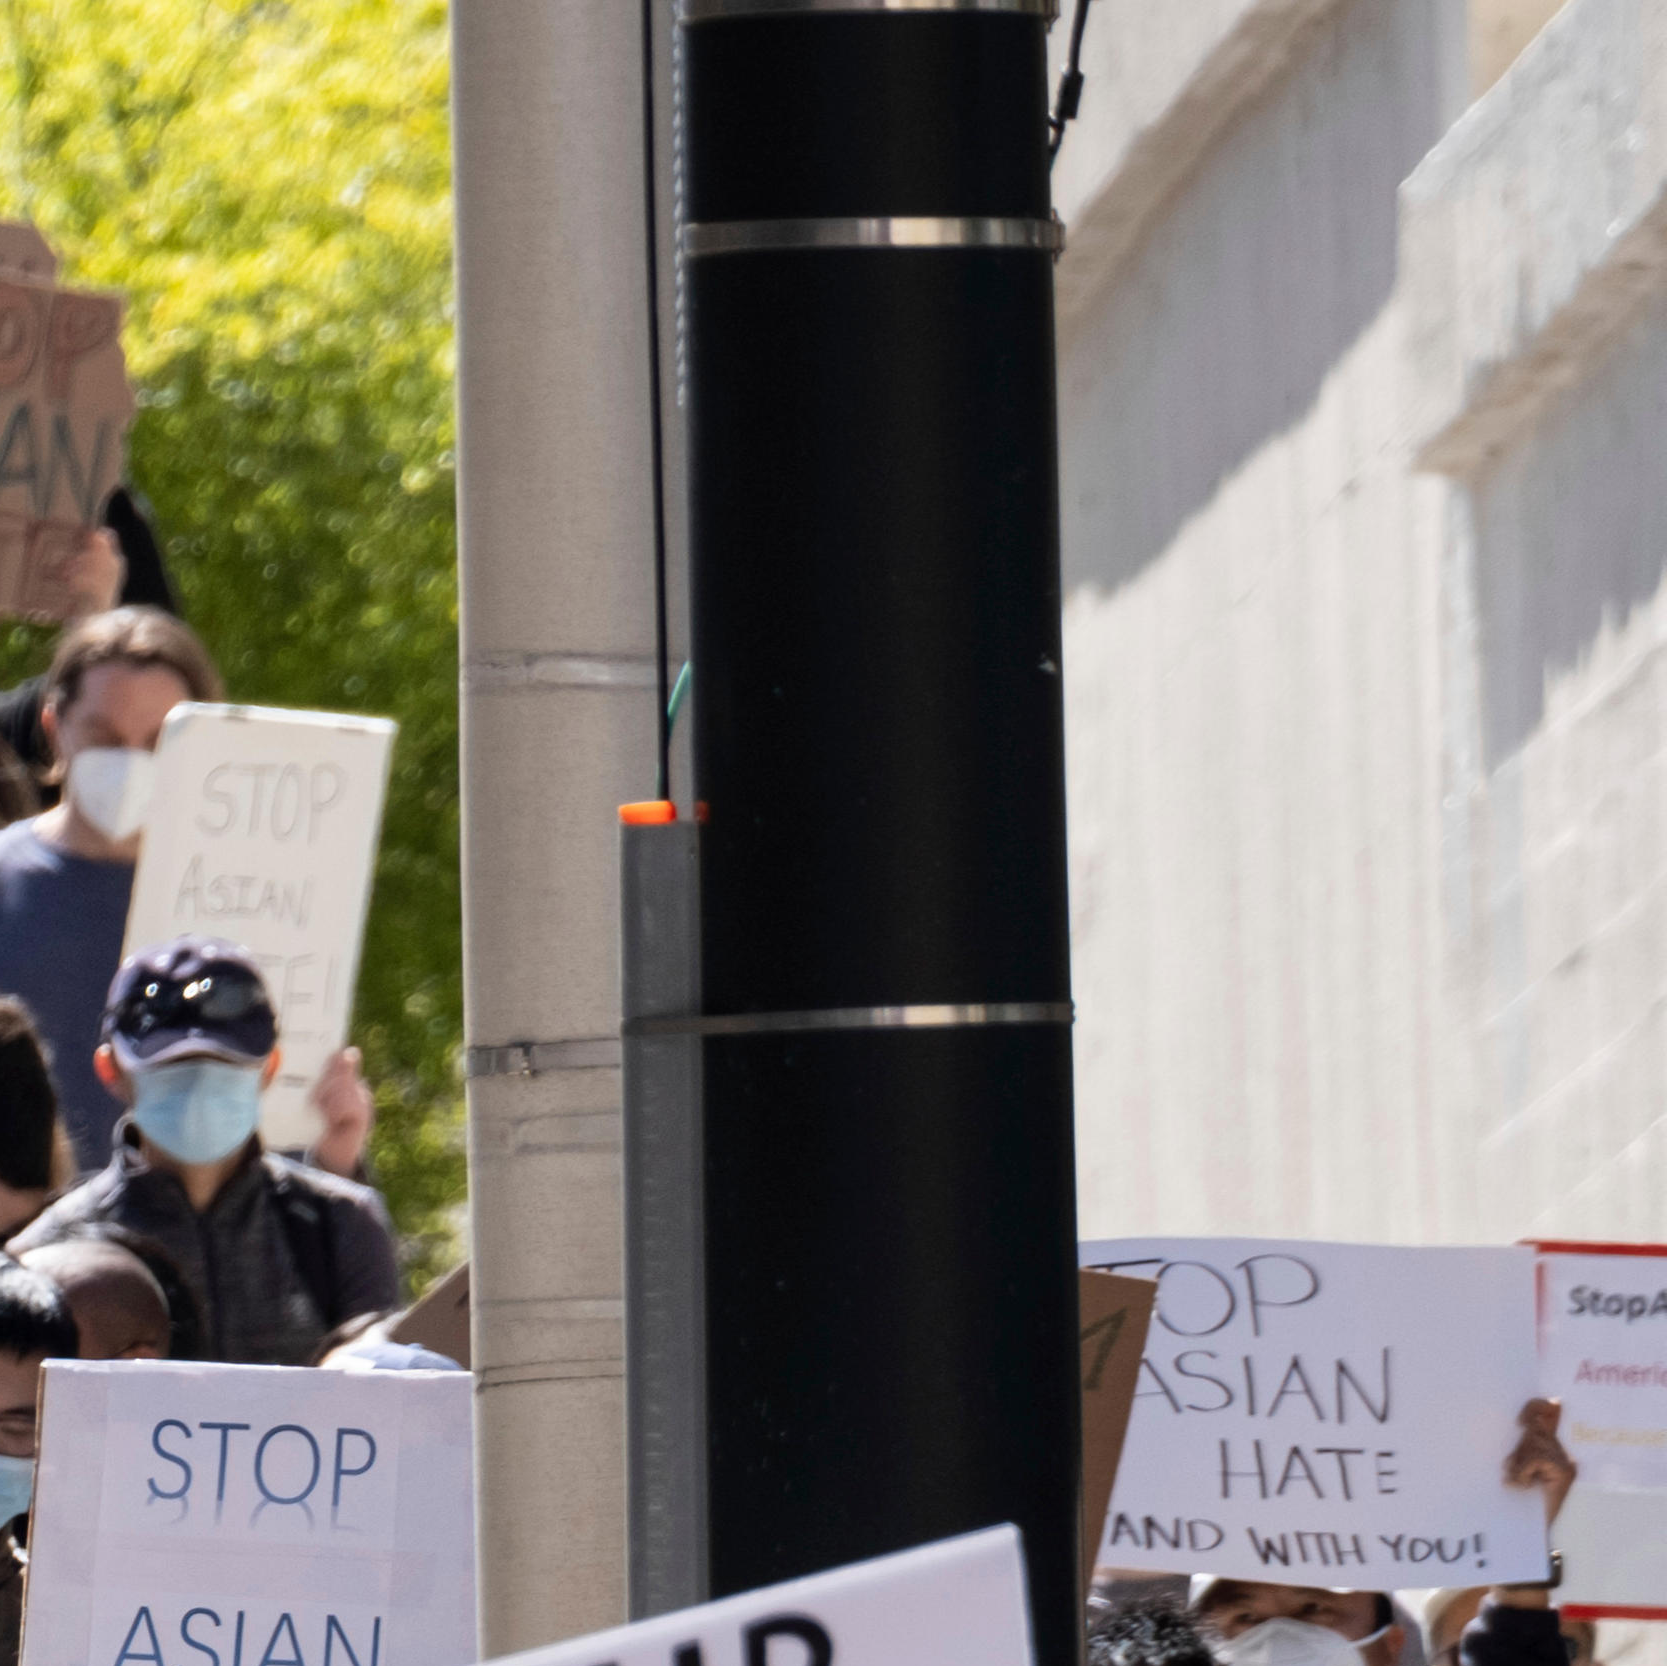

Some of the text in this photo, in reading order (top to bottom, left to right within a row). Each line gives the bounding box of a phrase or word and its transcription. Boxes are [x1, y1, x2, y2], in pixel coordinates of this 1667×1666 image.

[195, 760, 348, 843] STOP
[1131, 1347, 1390, 1424] ASIAN
[147, 1419, 378, 1506] STOP
[1219, 1440, 1399, 1500] HATE
[1247, 1527, 1364, 1566] WITH
[1378, 1534, 1487, 1568] YOU!
